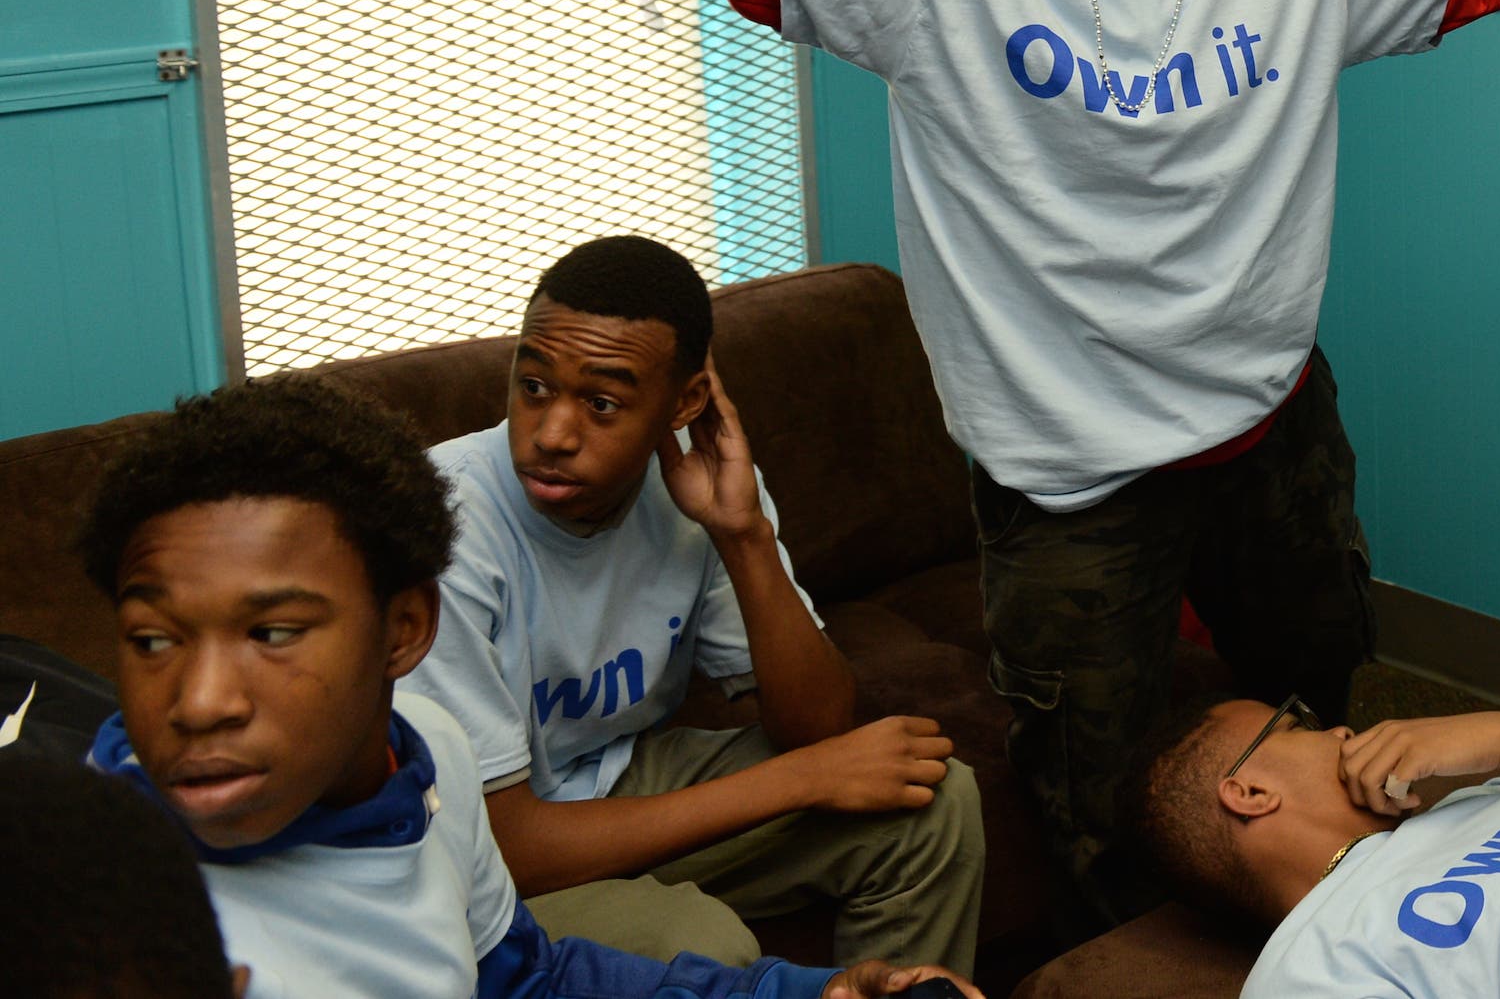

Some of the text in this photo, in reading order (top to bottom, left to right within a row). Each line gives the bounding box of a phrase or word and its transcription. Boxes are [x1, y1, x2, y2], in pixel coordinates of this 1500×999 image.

[1005, 23, 1280, 118] Own it.
[533, 648, 645, 728] wn
